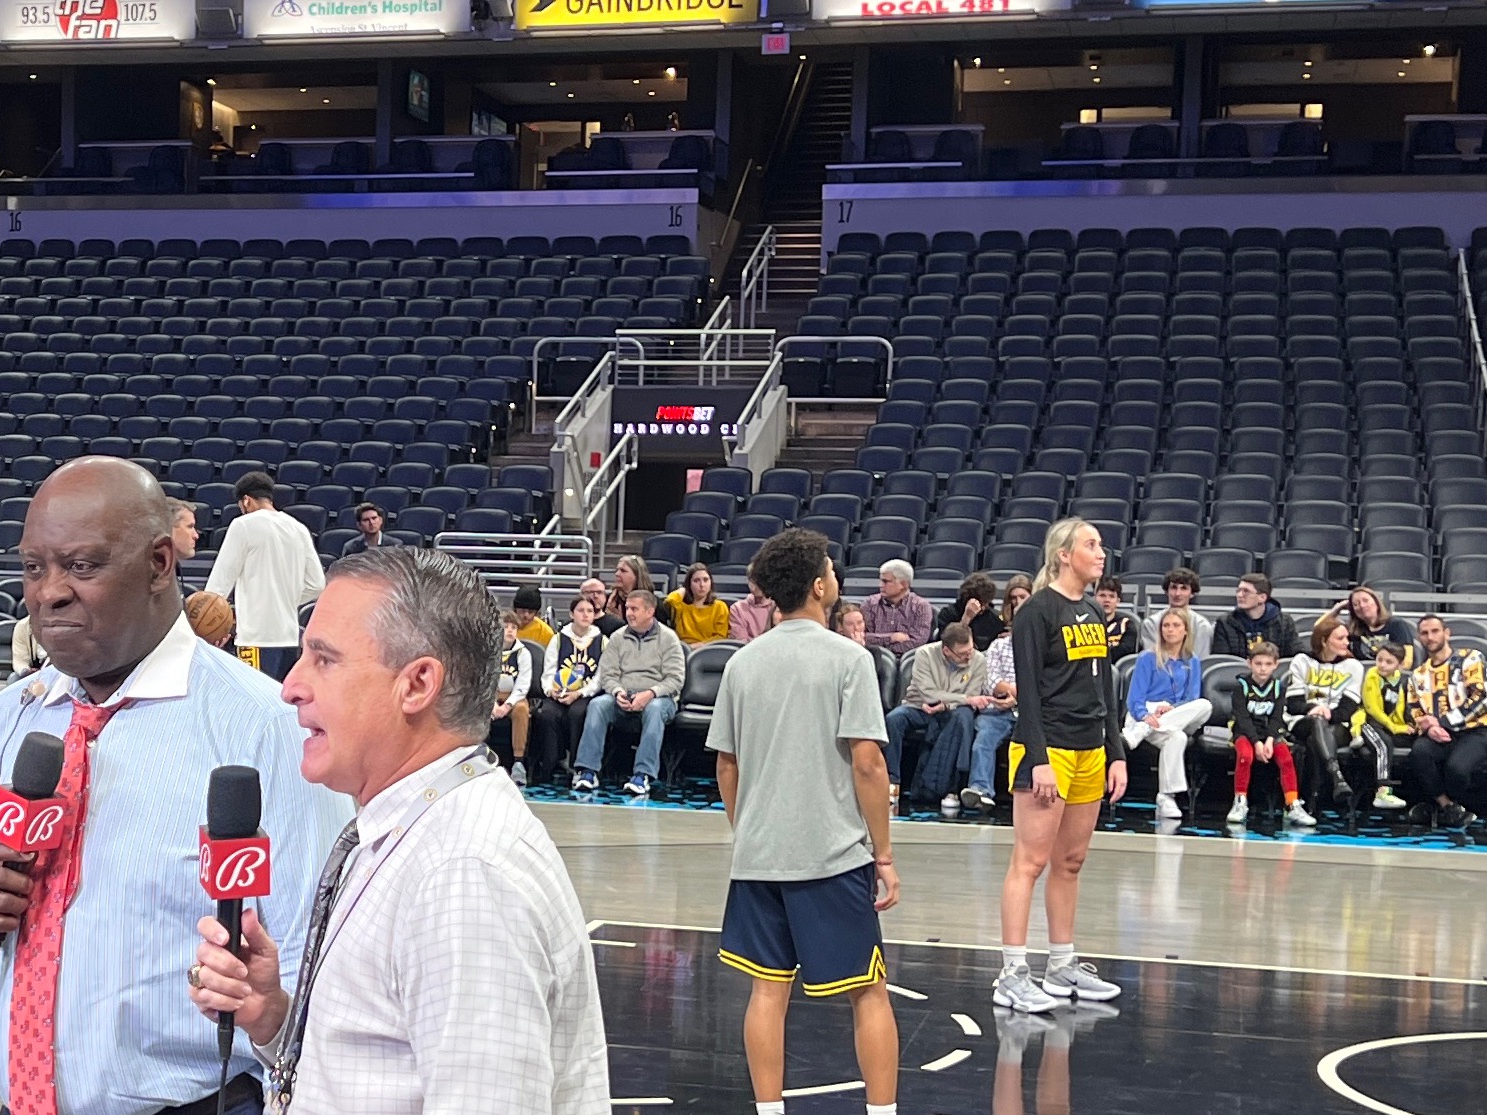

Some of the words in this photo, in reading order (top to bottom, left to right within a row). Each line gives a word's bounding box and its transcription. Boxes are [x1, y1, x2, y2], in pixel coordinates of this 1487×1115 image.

[21, 6, 50, 25] 93.5
[123, 3, 157, 22] 107.5
[308, 2, 378, 16] Children's
[382, 0, 443, 15] Hospital
[861, 0, 949, 16] LOCAL
[67, 12, 121, 39] fan
[668, 205, 683, 227] 16
[838, 200, 854, 224] 17
[8, 212, 22, 232] 16
[613, 423, 710, 435] HARDWOOD
[215, 846, 267, 892] B
